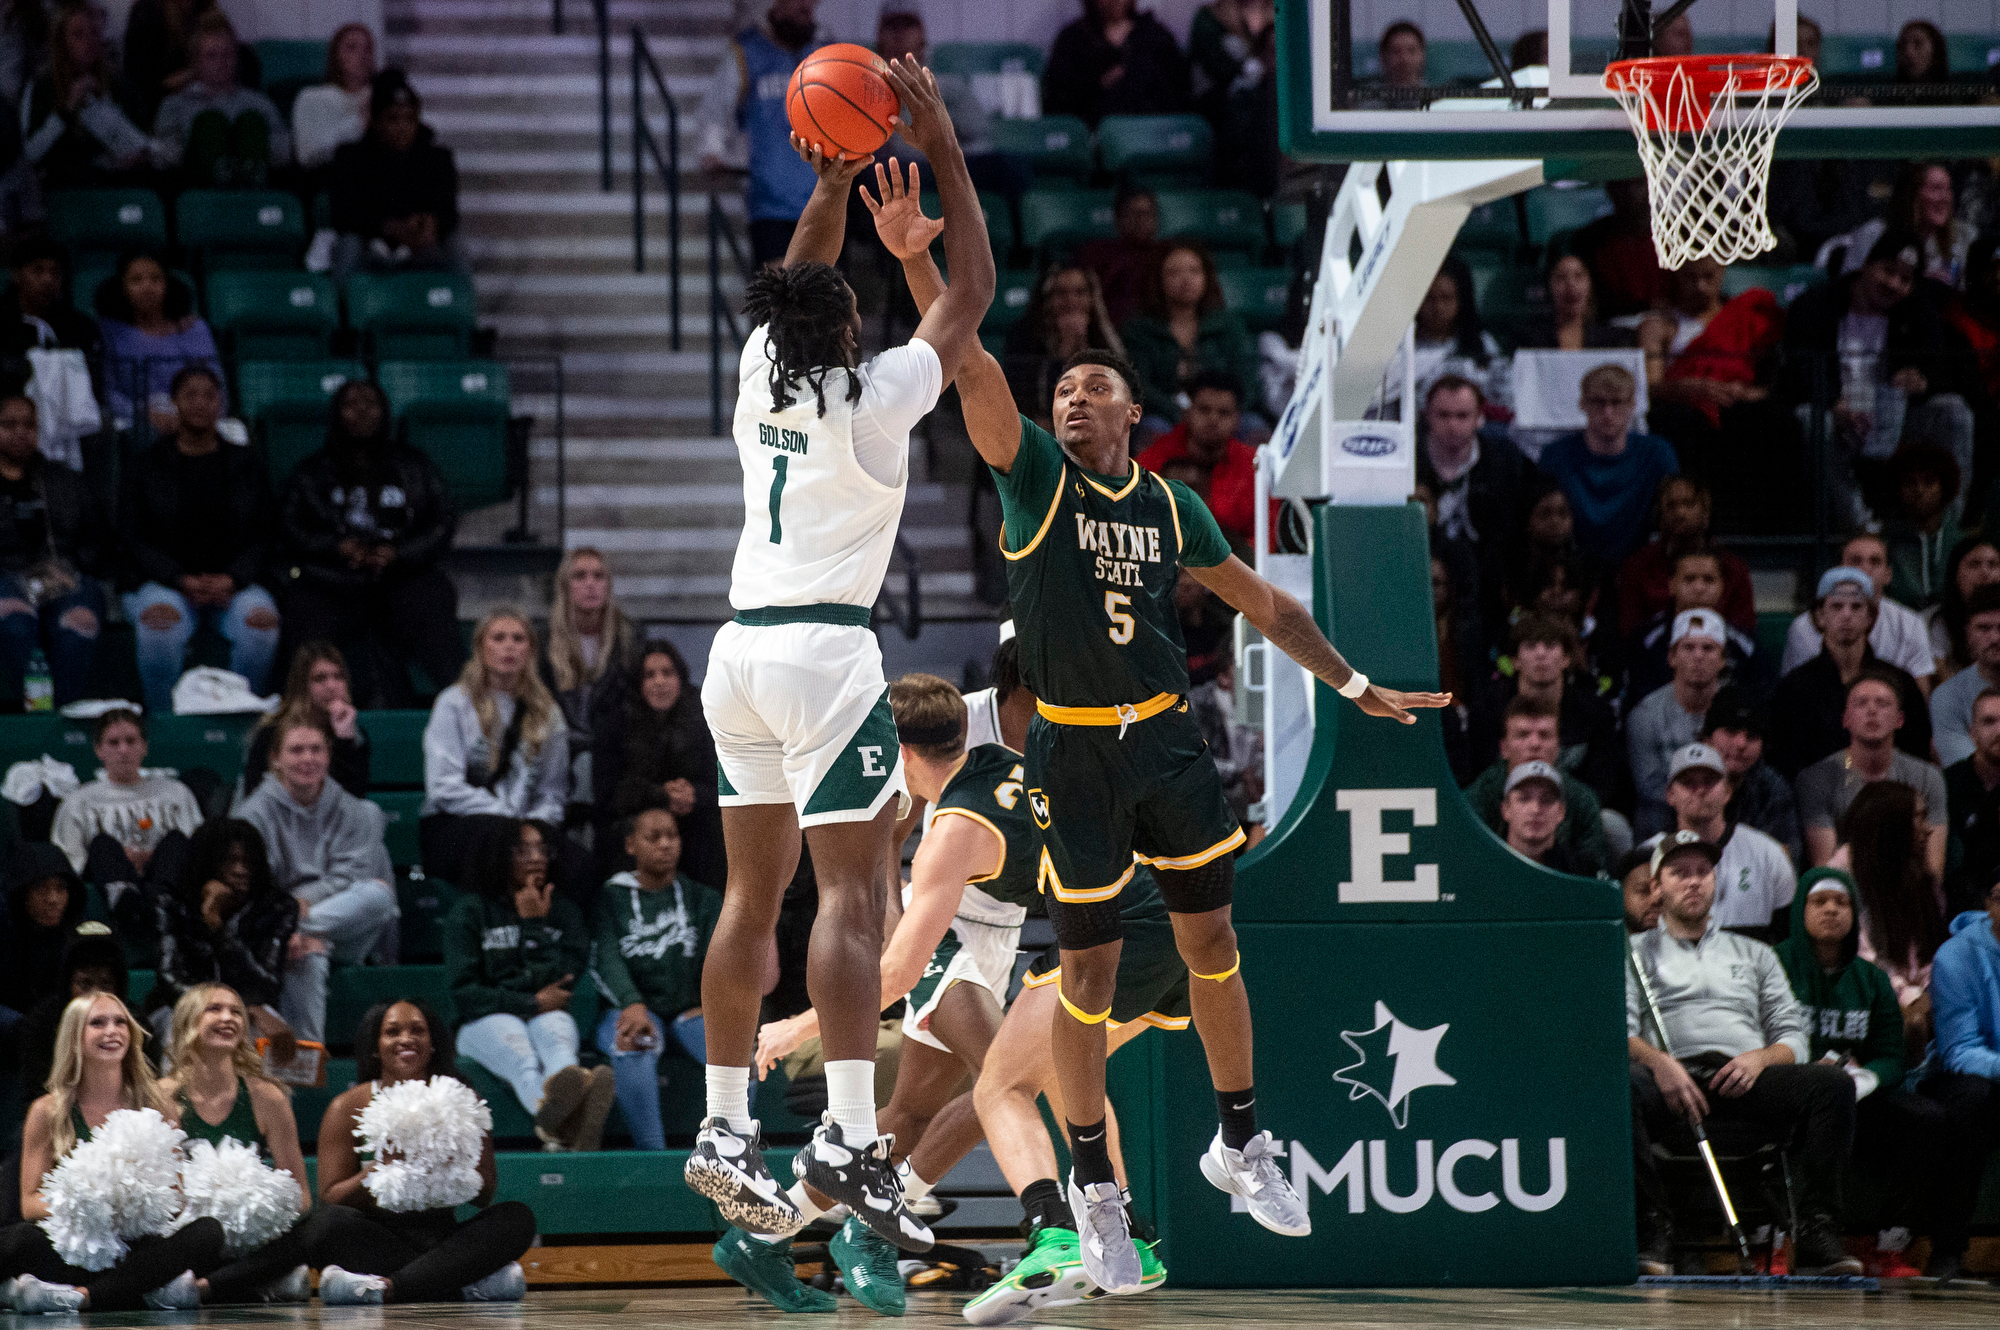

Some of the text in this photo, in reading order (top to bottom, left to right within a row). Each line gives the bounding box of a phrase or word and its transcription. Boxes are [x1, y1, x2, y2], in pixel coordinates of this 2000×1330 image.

[758, 422, 808, 455] GOLSON
[768, 454, 789, 545] 1
[1075, 512, 1162, 563] WAYNE
[1104, 590, 1136, 645] 5
[857, 745, 887, 777] E
[1335, 787, 1440, 903] E
